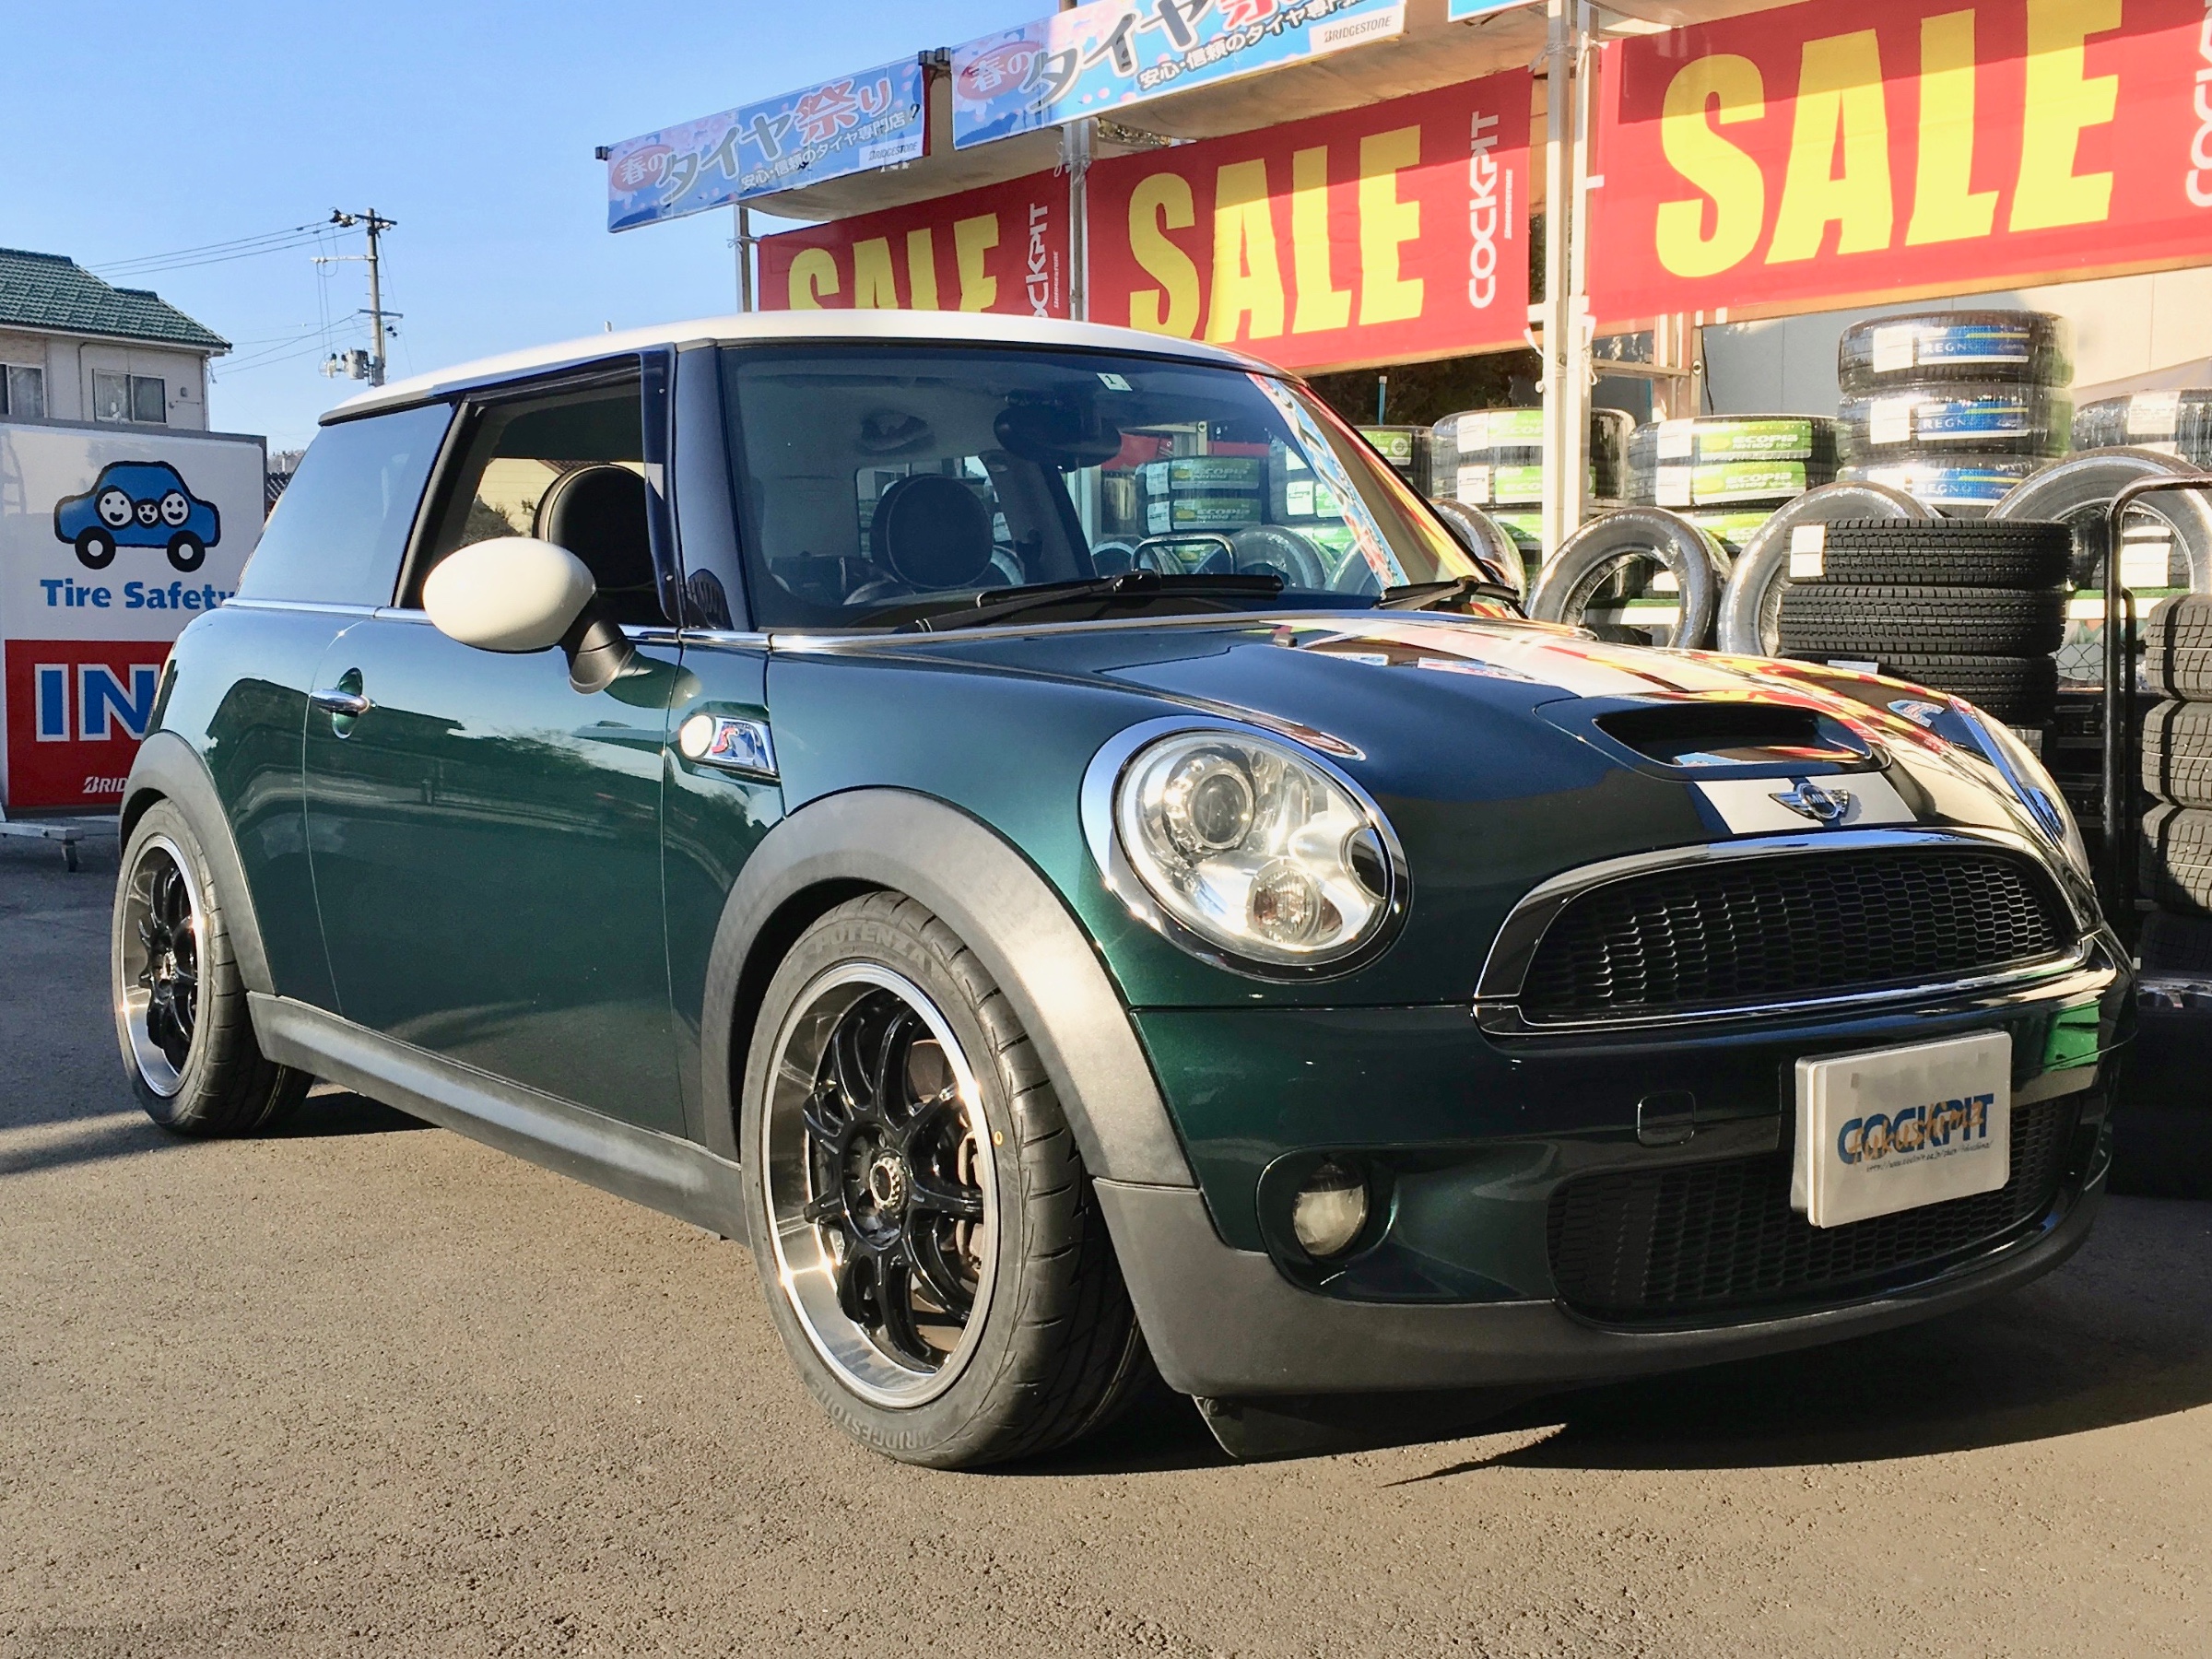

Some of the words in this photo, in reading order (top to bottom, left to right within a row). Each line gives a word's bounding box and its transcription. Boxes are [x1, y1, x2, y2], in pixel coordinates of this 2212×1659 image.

[1324, 16, 1392, 43] BRIDGESTONE
[869, 141, 918, 161] BRIDGESTONE
[1656, 0, 2122, 277] SALE
[1129, 124, 1424, 344] SALE
[1468, 111, 1499, 309] COCKPIT
[1026, 203, 1049, 317] CKPIT
[1924, 342, 1978, 353] REGN
[1923, 418, 1978, 429] REGN
[40, 578, 112, 607] Tire
[34, 663, 160, 742] IN
[1838, 1093, 1994, 1165] COCKPIT
